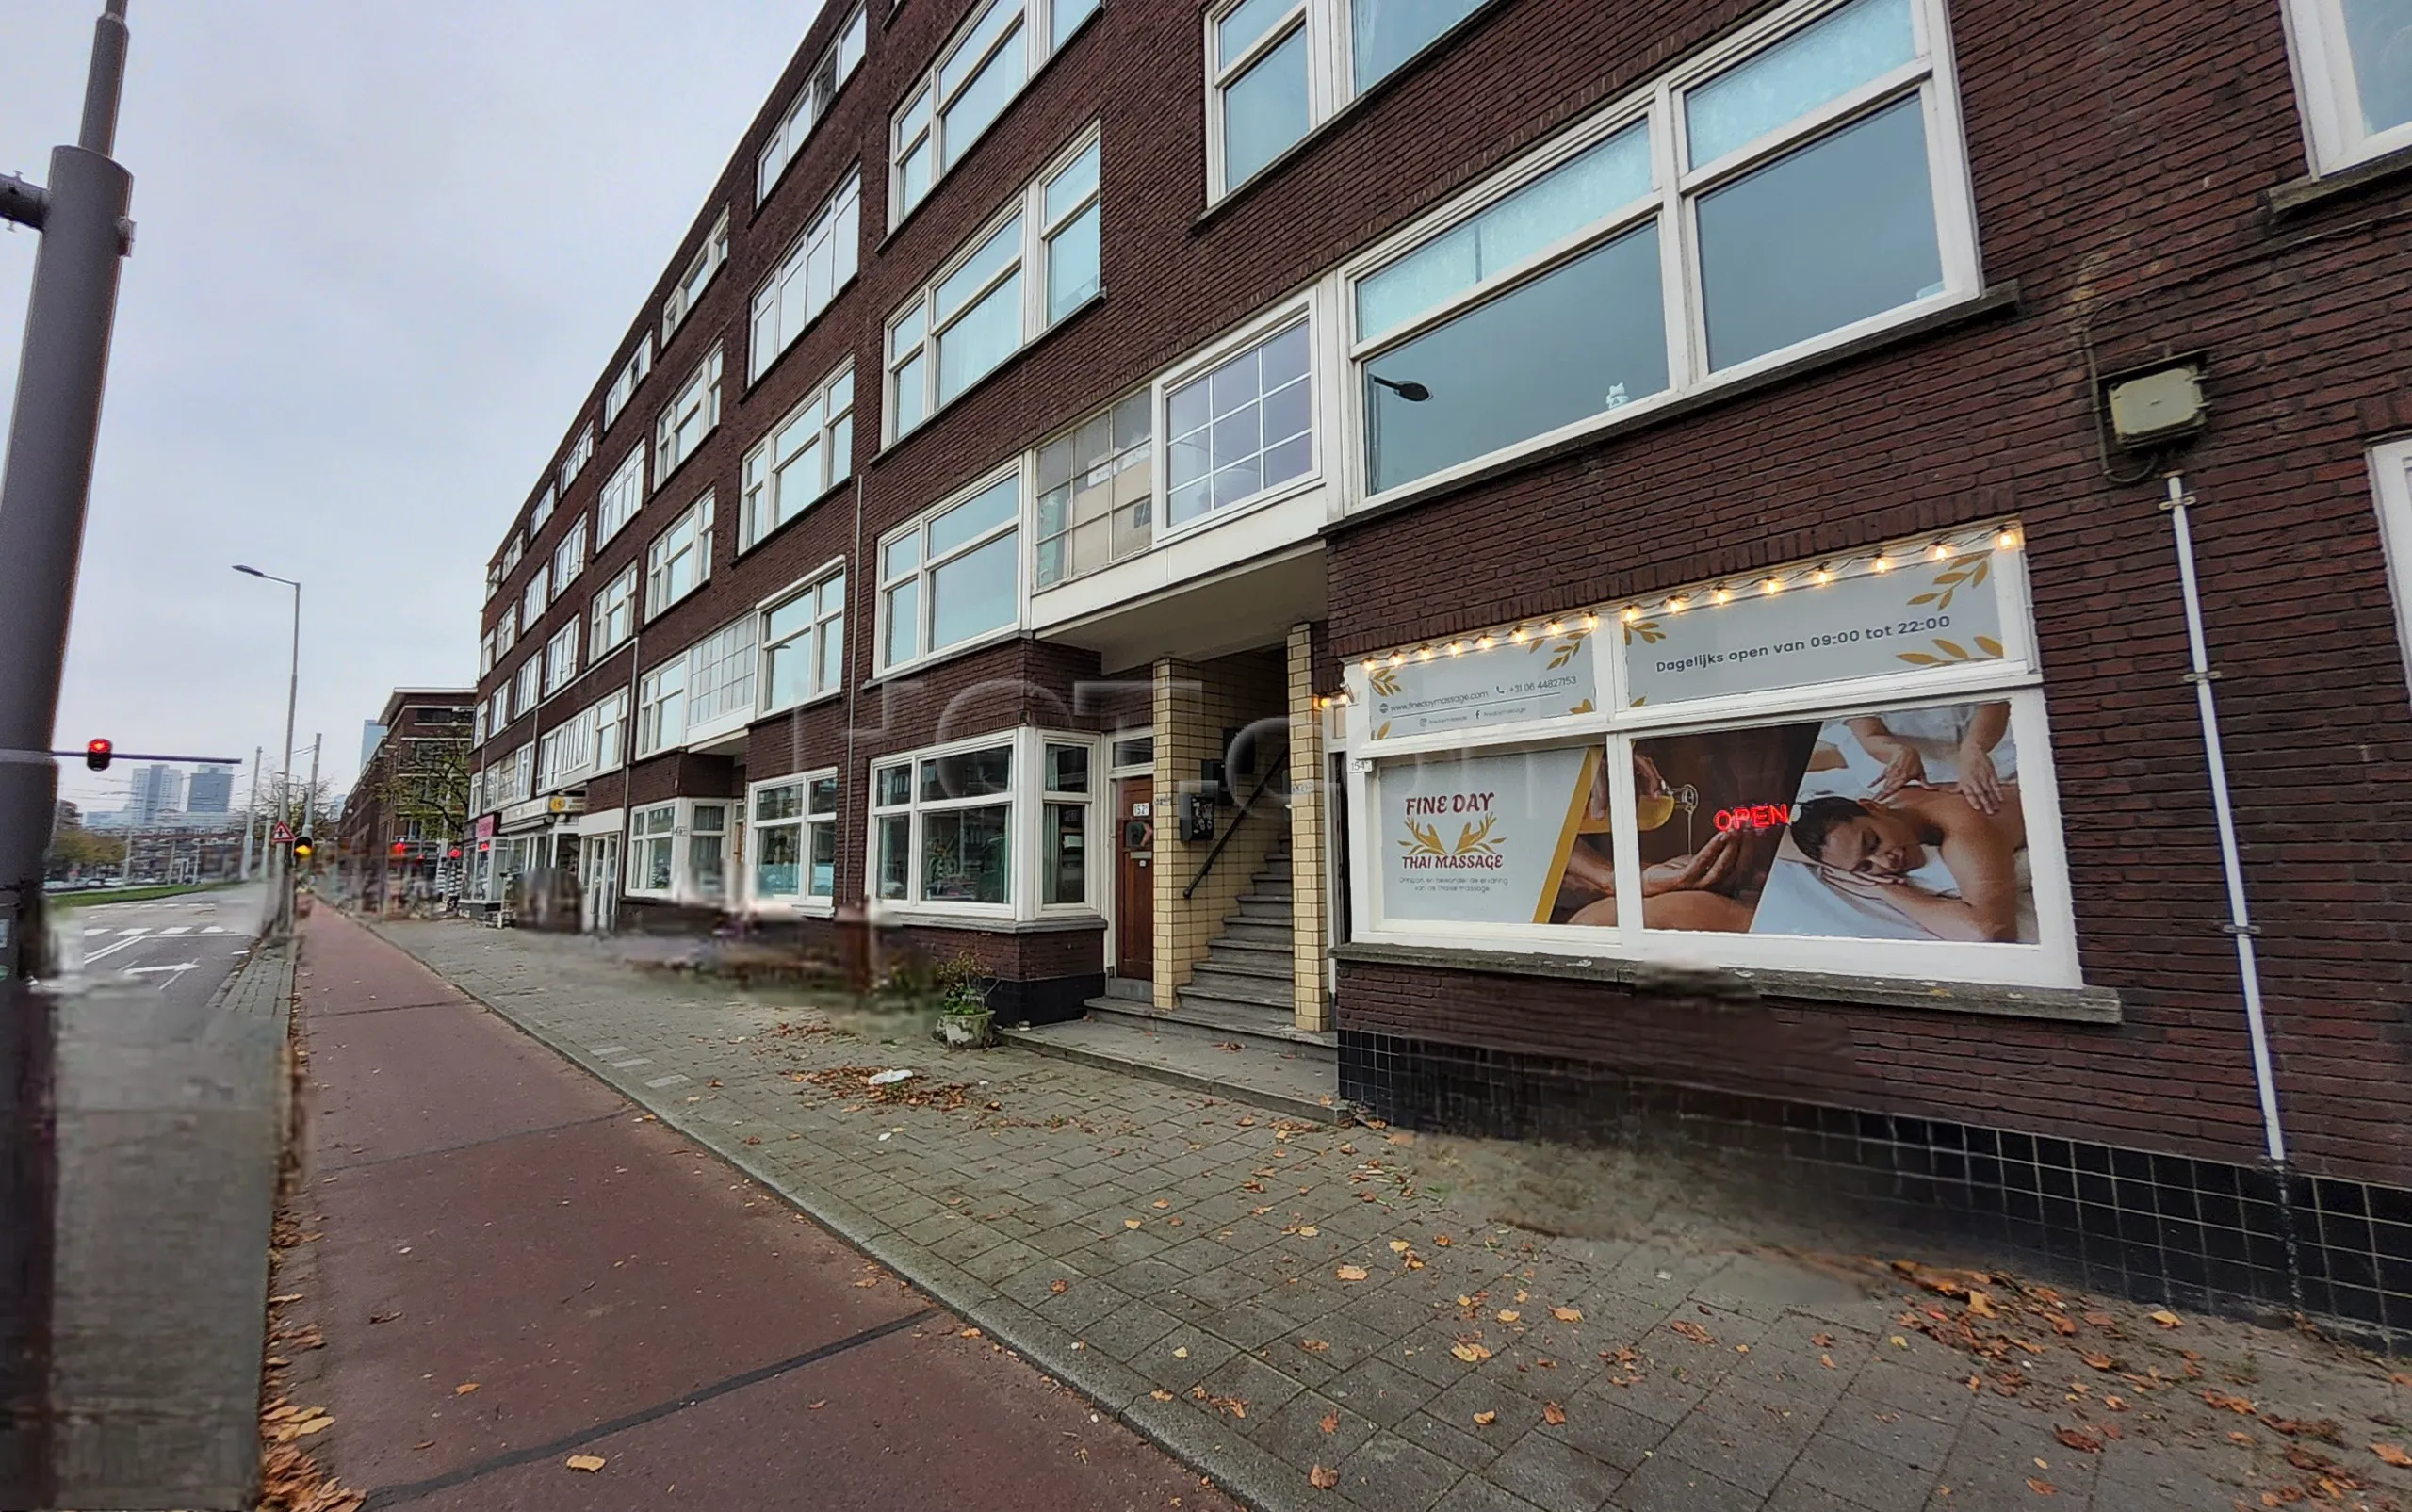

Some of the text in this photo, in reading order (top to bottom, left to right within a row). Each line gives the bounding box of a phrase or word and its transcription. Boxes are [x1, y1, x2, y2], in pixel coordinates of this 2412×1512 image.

[1655, 615, 1951, 673] Dagelijks open van 09:00 tot 22:00
[1508, 675, 1577, 693] +31 06 44827153
[1390, 690, 1490, 712] www.finedaymassage.com
[1405, 791, 1495, 816] FINE DAY
[1713, 803, 1788, 831] OPEN
[1401, 854, 1504, 870] THAI MASSAGE
